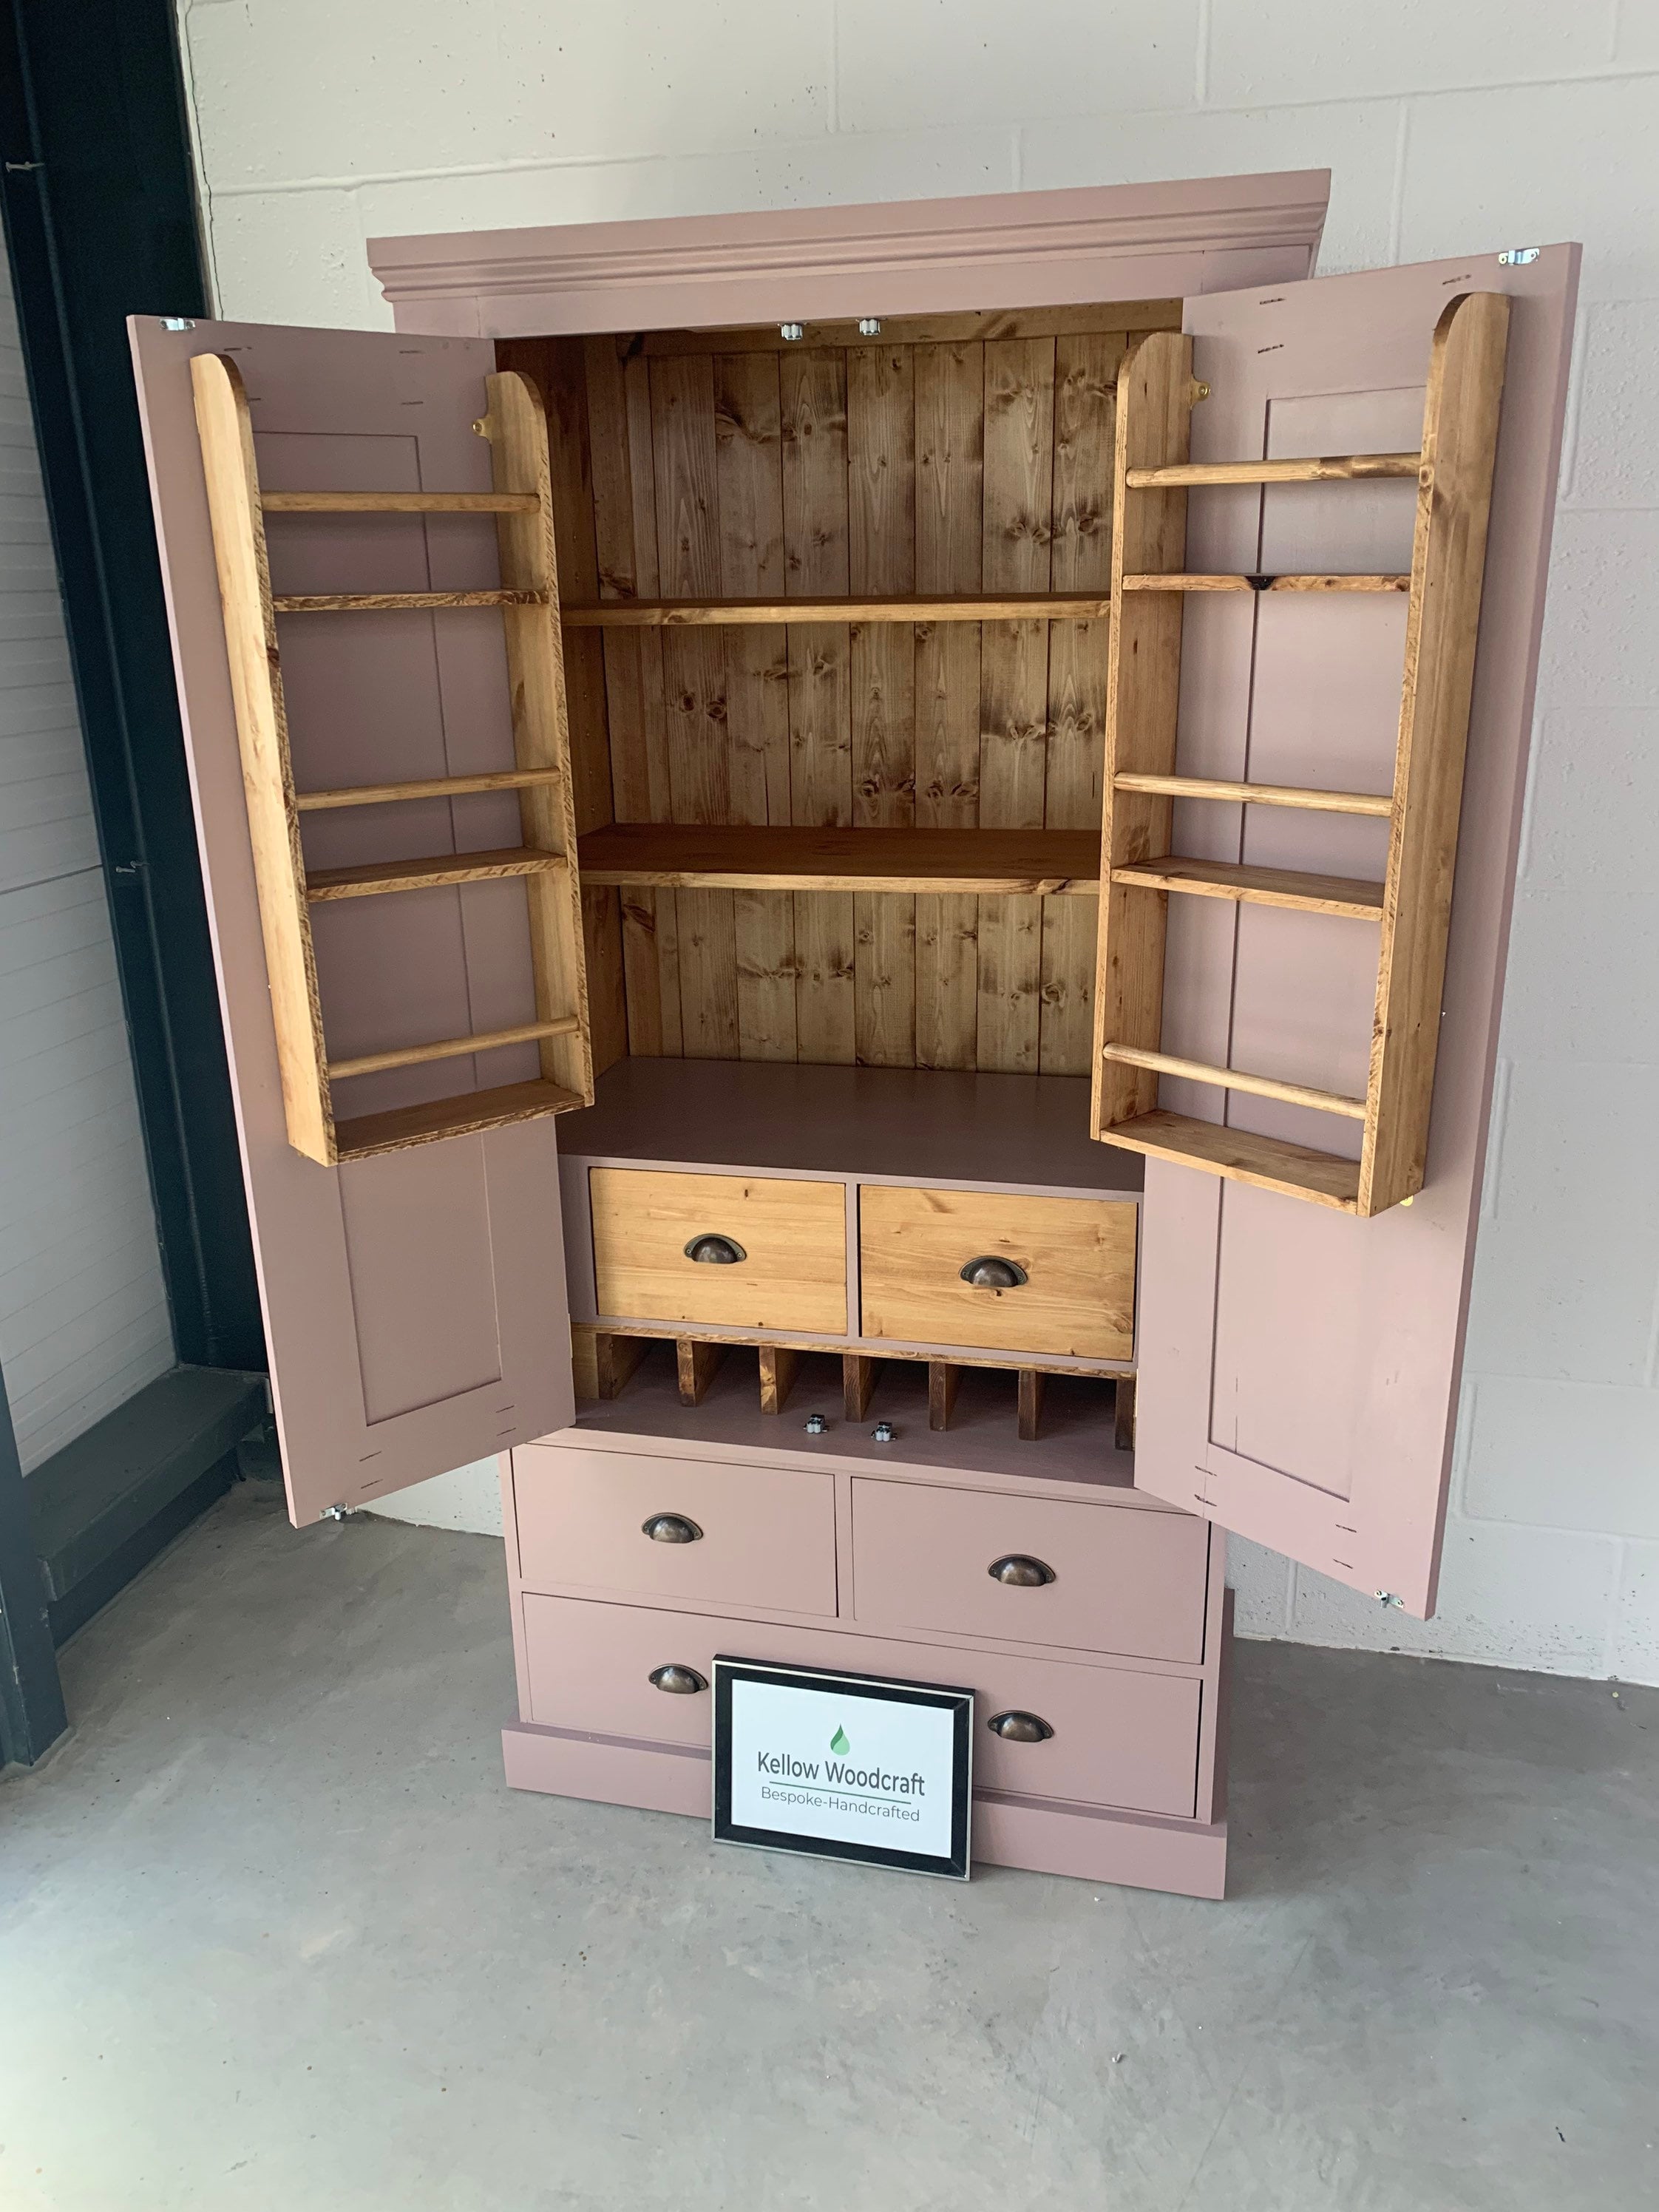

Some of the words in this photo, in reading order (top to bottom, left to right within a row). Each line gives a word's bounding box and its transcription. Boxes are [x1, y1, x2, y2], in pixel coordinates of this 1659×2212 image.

[758, 1751, 820, 1780] Kellow
[824, 1760, 926, 1797] Woodcraft
[761, 1786, 920, 1822] Bespoke-Handcrafted
